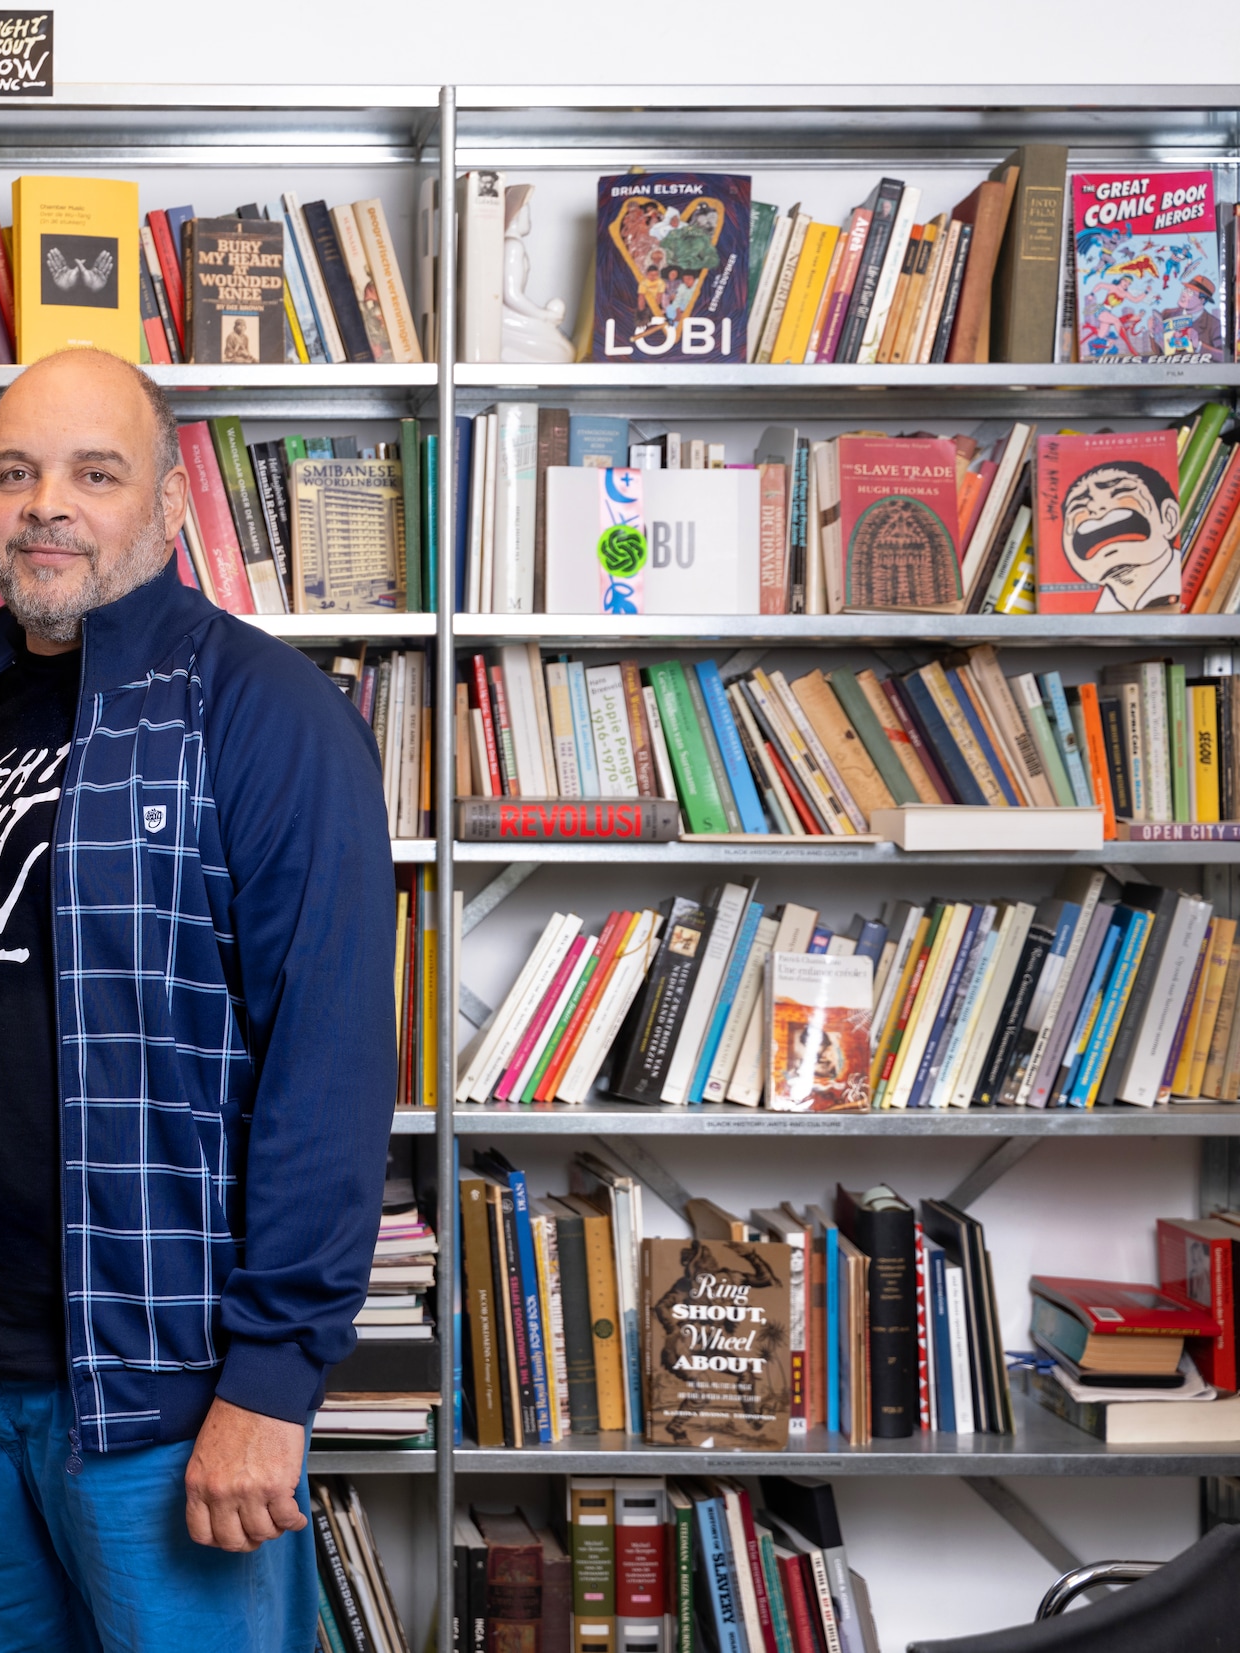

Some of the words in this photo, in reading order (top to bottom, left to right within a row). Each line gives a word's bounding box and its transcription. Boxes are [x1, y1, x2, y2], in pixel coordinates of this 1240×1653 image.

[611, 184, 651, 197] BRIAN
[654, 184, 703, 196] ELSTAK
[1082, 185, 1095, 194] THE
[1096, 178, 1149, 201] GREAT
[1084, 195, 1155, 228] COMIC
[1161, 183, 1207, 210] BOOK
[1154, 203, 1205, 231] HEROES
[217, 239, 262, 253] BURY
[199, 252, 226, 265] MY
[229, 253, 282, 267] HEART
[199, 274, 282, 289] WOUNDED
[233, 266, 248, 276] AT
[368, 207, 392, 277] geografische
[387, 278, 410, 352] verkenningen
[219, 288, 262, 301] KNEE
[239, 304, 264, 312] BROWN
[605, 316, 732, 356] LOBI
[226, 428, 242, 477] WANDELAAR
[303, 465, 397, 477] SMIBANESE
[854, 463, 899, 477] SLAVE
[902, 465, 953, 478] TRADE
[237, 477, 250, 508] ONDER
[303, 477, 397, 488] WOORDENBOEK
[857, 485, 890, 494] HUGH
[894, 486, 939, 495] THOMAS
[244, 509, 252, 521] DE
[247, 521, 260, 554] PALMEN
[592, 709, 618, 783] 1916-1970
[603, 694, 622, 733] Jopie
[615, 737, 637, 789] Pengel
[500, 805, 641, 838] REVOLUSI
[1143, 825, 1182, 840] OPEN
[1191, 825, 1225, 839] CITY
[691, 1272, 751, 1305] Ring
[671, 1303, 767, 1325] SHOUT,
[681, 1324, 757, 1352] Wheel
[672, 1356, 767, 1375] ABOUT
[713, 1552, 736, 1624] SLAVERY
